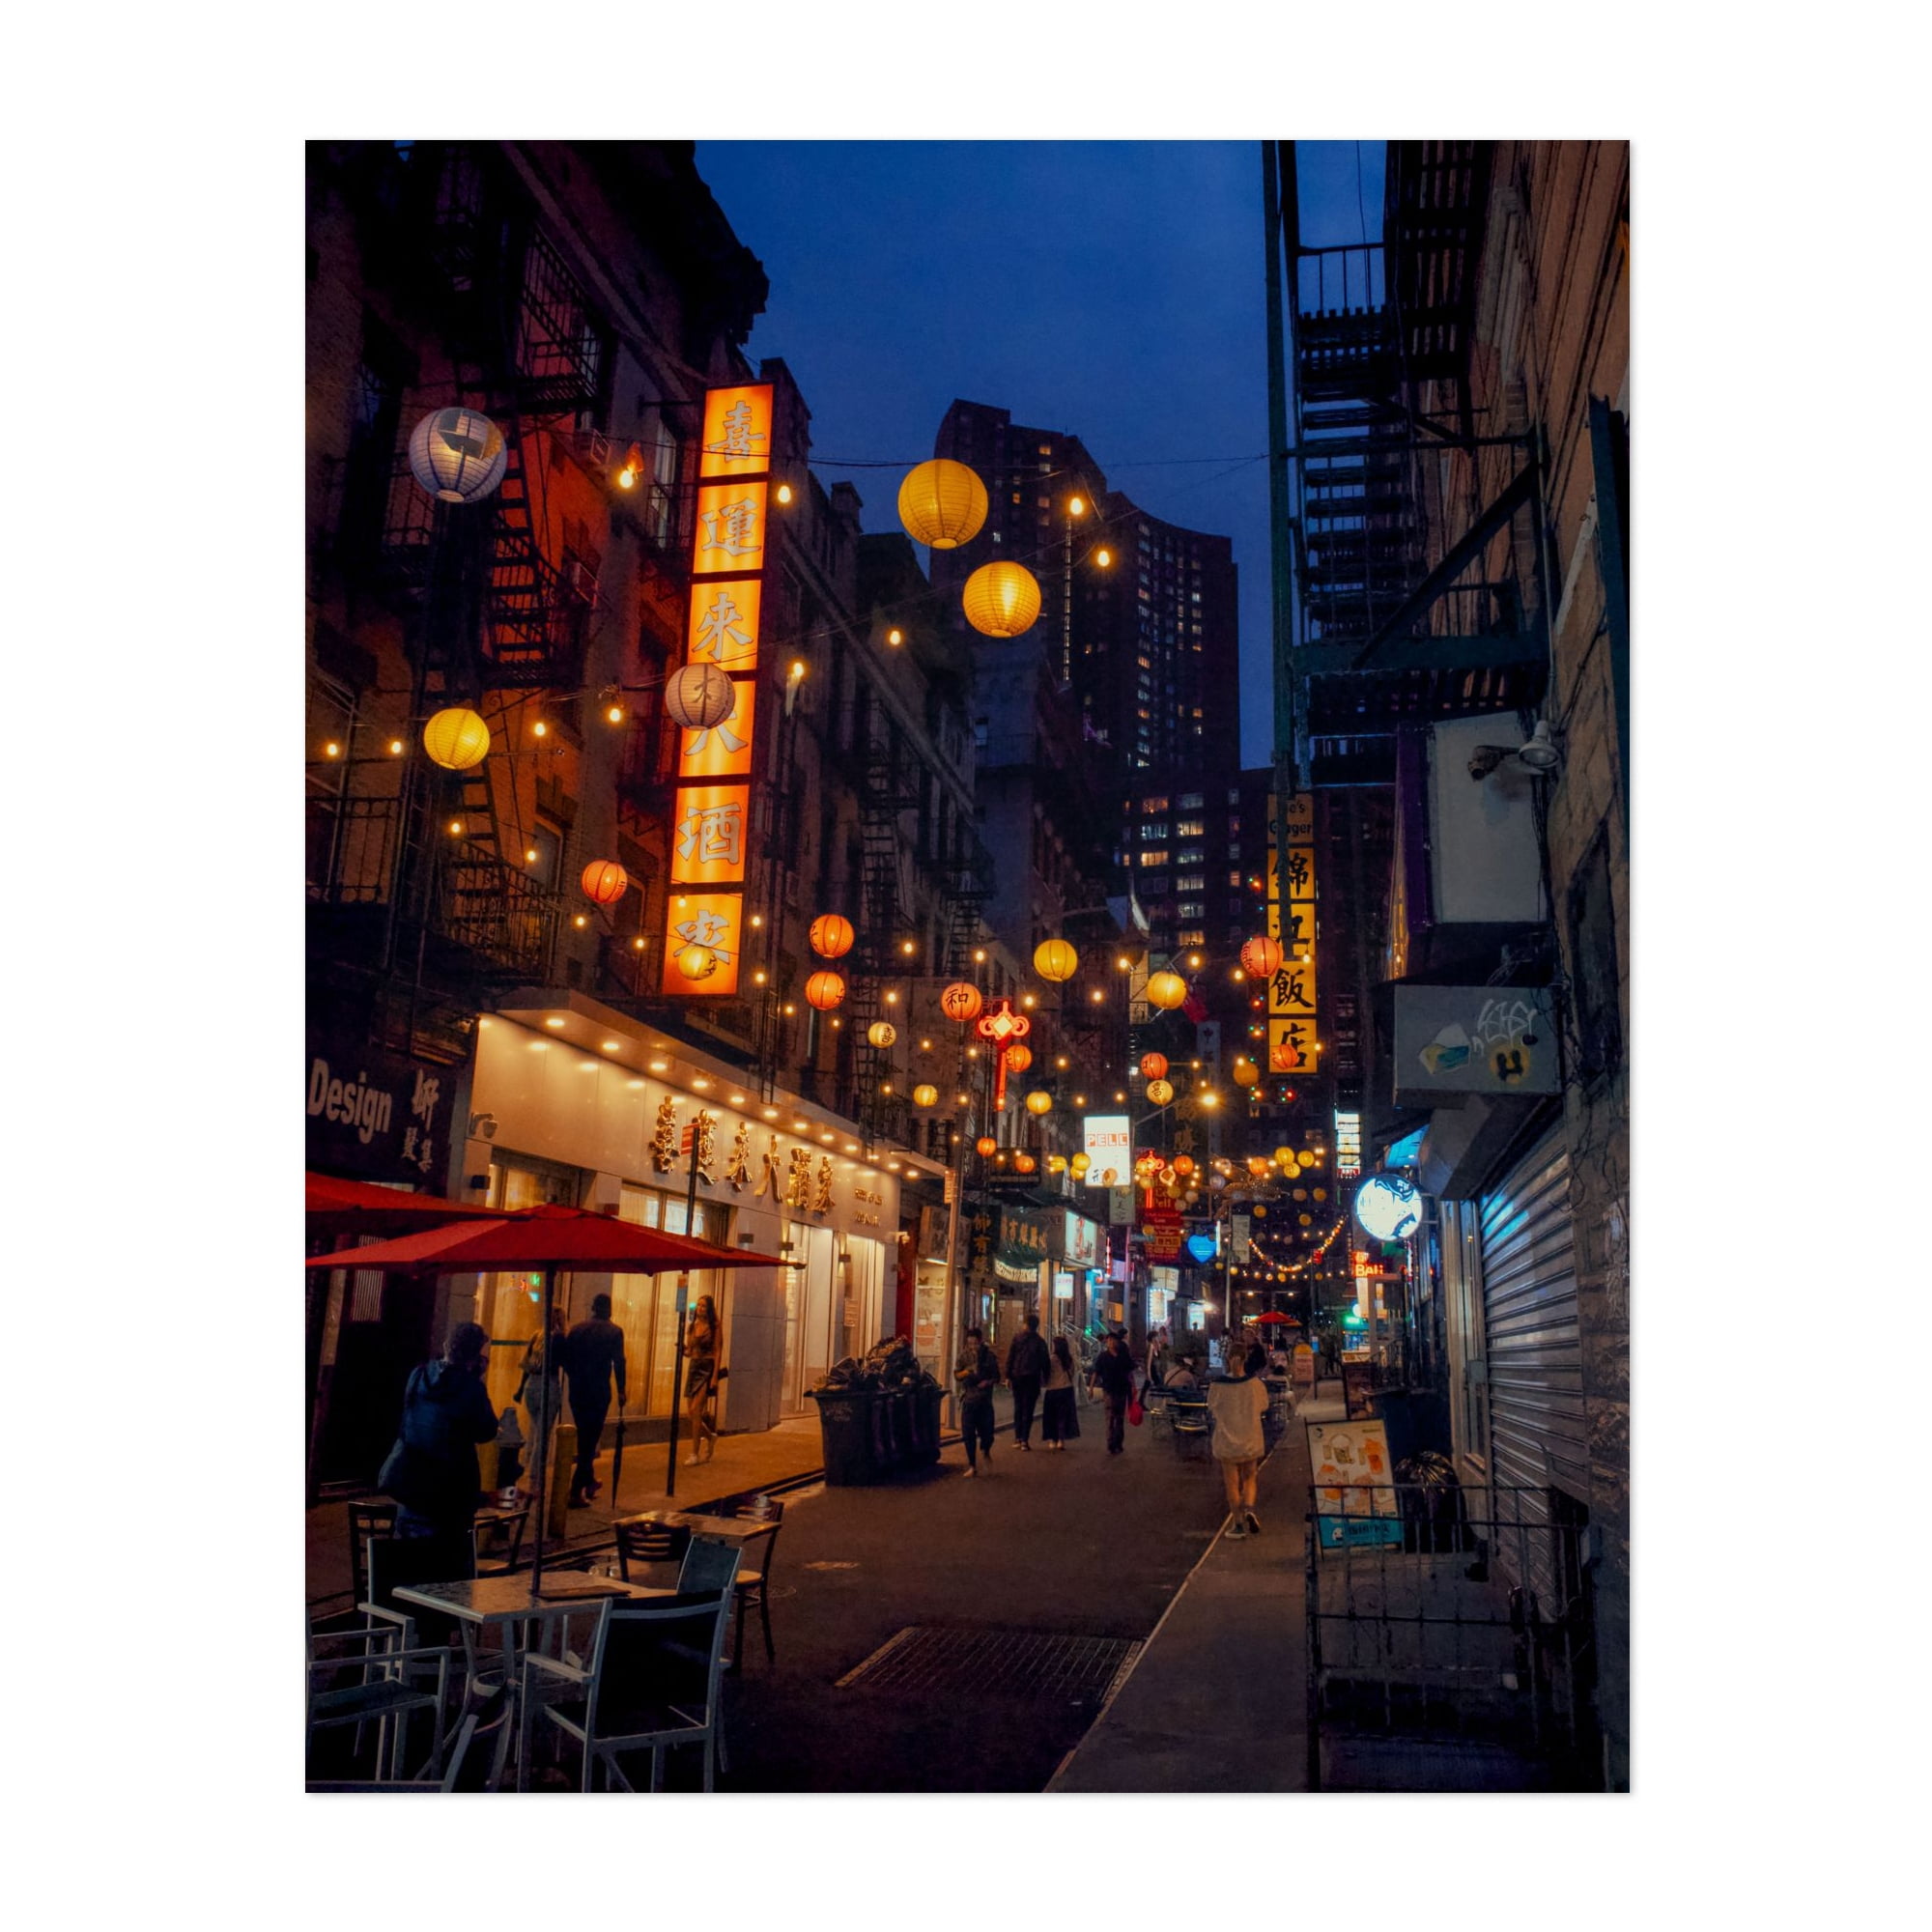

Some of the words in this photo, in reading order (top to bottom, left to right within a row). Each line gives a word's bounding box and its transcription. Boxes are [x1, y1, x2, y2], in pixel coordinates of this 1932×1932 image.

[1270, 819, 1311, 837] Gnger
[946, 989, 968, 1009] 和
[307, 1058, 392, 1144] Design
[1087, 1133, 1128, 1147] PELL
